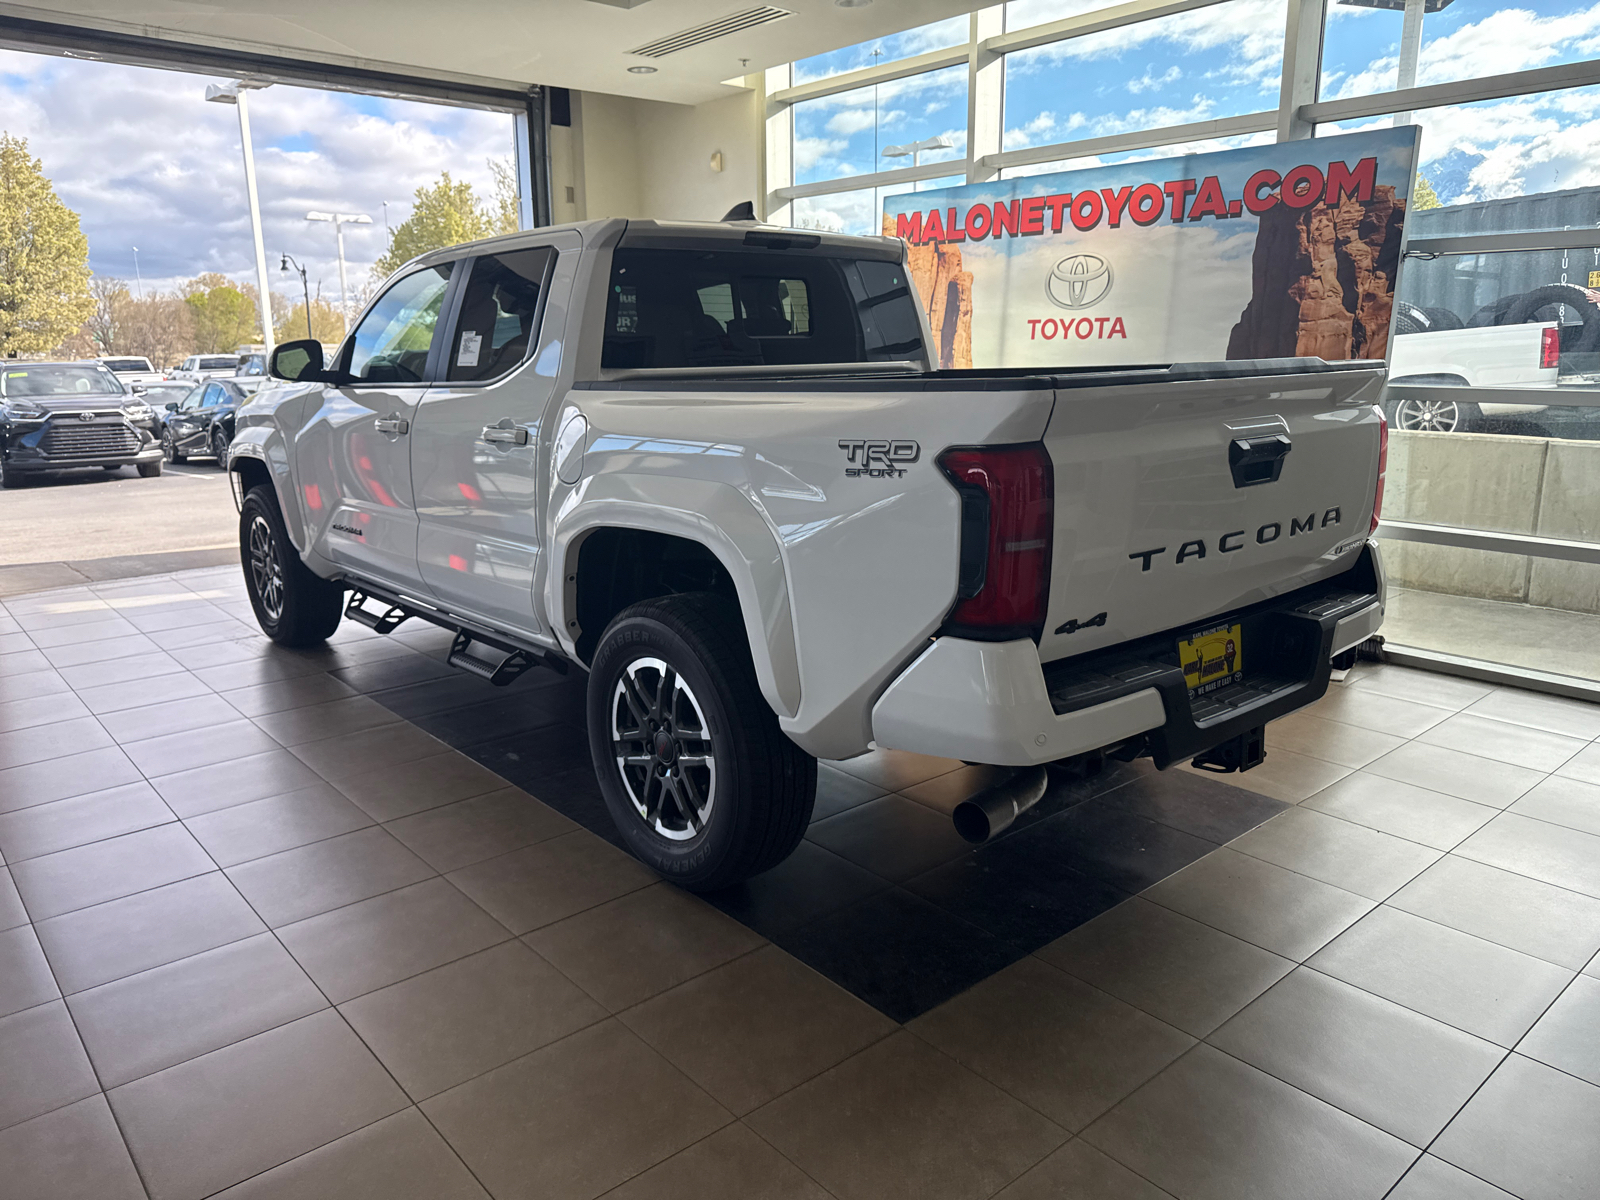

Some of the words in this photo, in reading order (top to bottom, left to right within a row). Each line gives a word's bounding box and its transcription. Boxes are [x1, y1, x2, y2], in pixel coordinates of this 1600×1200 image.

[896, 156, 1377, 247] MALONETOYOTA.COM
[1027, 317, 1127, 340] TOYOTA
[838, 439, 921, 470] TRD
[845, 468, 908, 479] SPORT
[1128, 505, 1341, 572] TACOMA
[599, 630, 650, 667] GRABBER
[1227, 643, 1233, 653] 32
[1198, 686, 1204, 695] WE
[1205, 683, 1217, 692] MAKE
[1222, 676, 1231, 686] EASY
